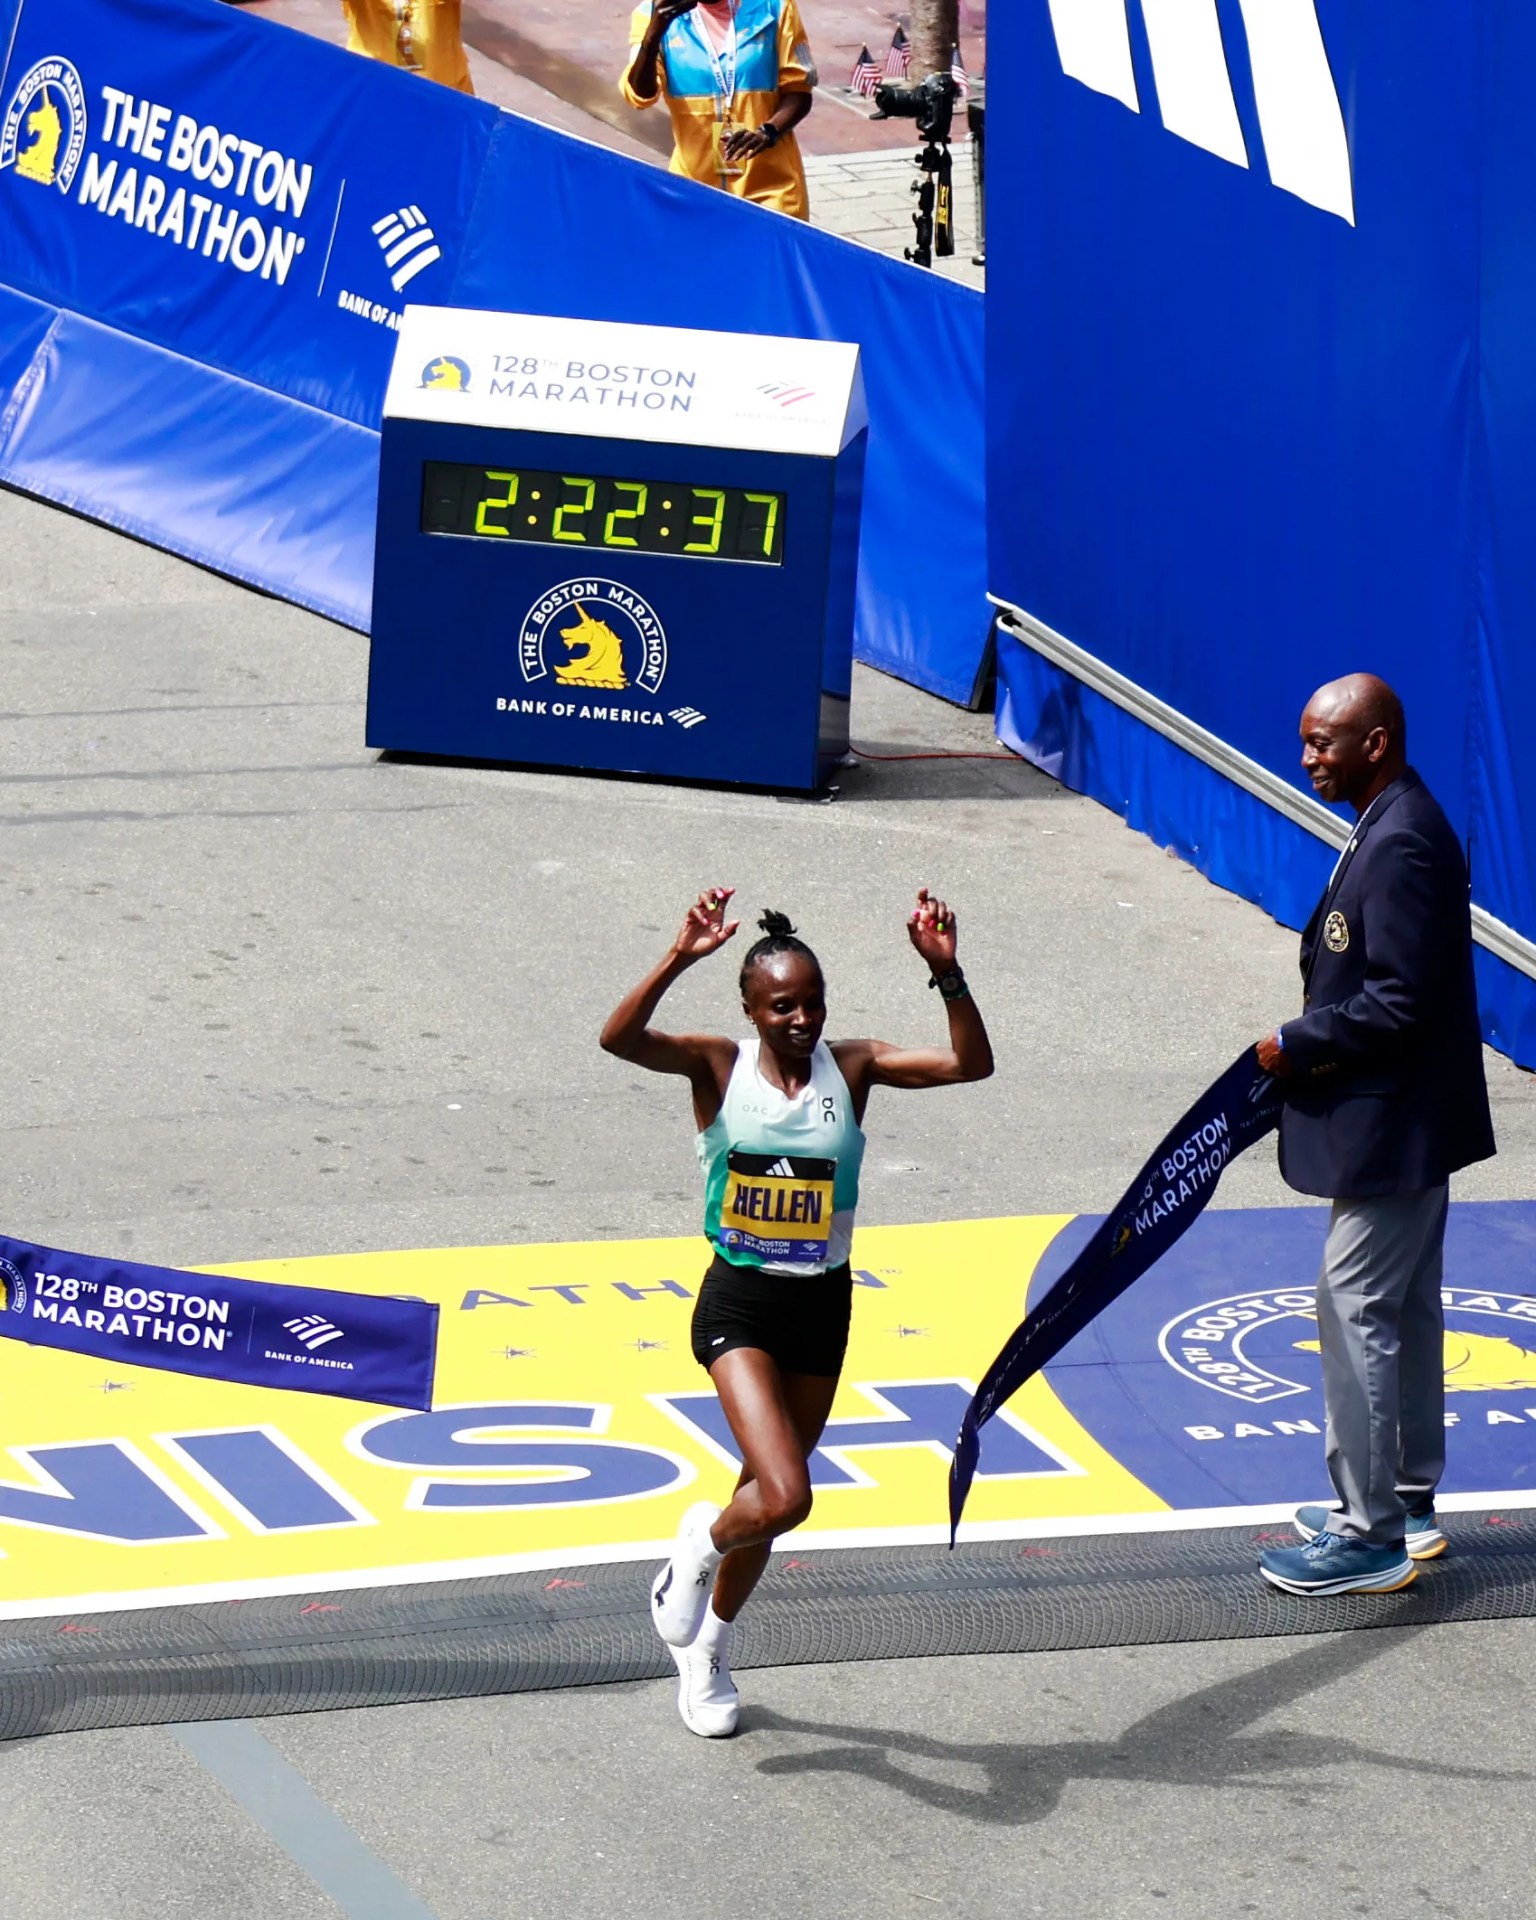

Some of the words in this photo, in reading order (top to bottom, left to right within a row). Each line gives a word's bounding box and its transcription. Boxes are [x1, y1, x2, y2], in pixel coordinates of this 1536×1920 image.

[4, 111, 19, 154] THE
[18, 64, 62, 104] BOSTON
[63, 71, 83, 181] MARATHON
[101, 86, 172, 162] THE
[168, 114, 313, 218] BOSTON
[338, 289, 372, 319] BANK
[371, 304, 389, 324] OF
[492, 354, 559, 376] 128TH
[565, 361, 697, 389] BOSTON
[489, 378, 692, 412] MARATHON
[475, 471, 779, 557] 2:22:37
[523, 631, 538, 670] THE
[532, 582, 598, 625] BOSTON
[608, 586, 662, 682] MARATHON
[496, 697, 547, 715] BANK
[552, 702, 576, 717] OF
[579, 705, 665, 726] AMERICA
[1161, 1112, 1229, 1182] BOSTON
[732, 1182, 824, 1225] HELLEN
[1135, 1137, 1232, 1236] MARATHON
[744, 1240, 790, 1255] MARATHON
[758, 1239, 791, 1249] BOSTON
[33, 1271, 99, 1301] 128TH
[103, 1284, 230, 1324] BOSTON
[1181, 1294, 1317, 1342] BOSTO
[264, 1350, 292, 1364] BANK
[294, 1355, 307, 1365] OF
[308, 1357, 354, 1370] AMERICA
[1181, 1347, 1275, 1394] 128TH
[1183, 1419, 1328, 1440] BAN
